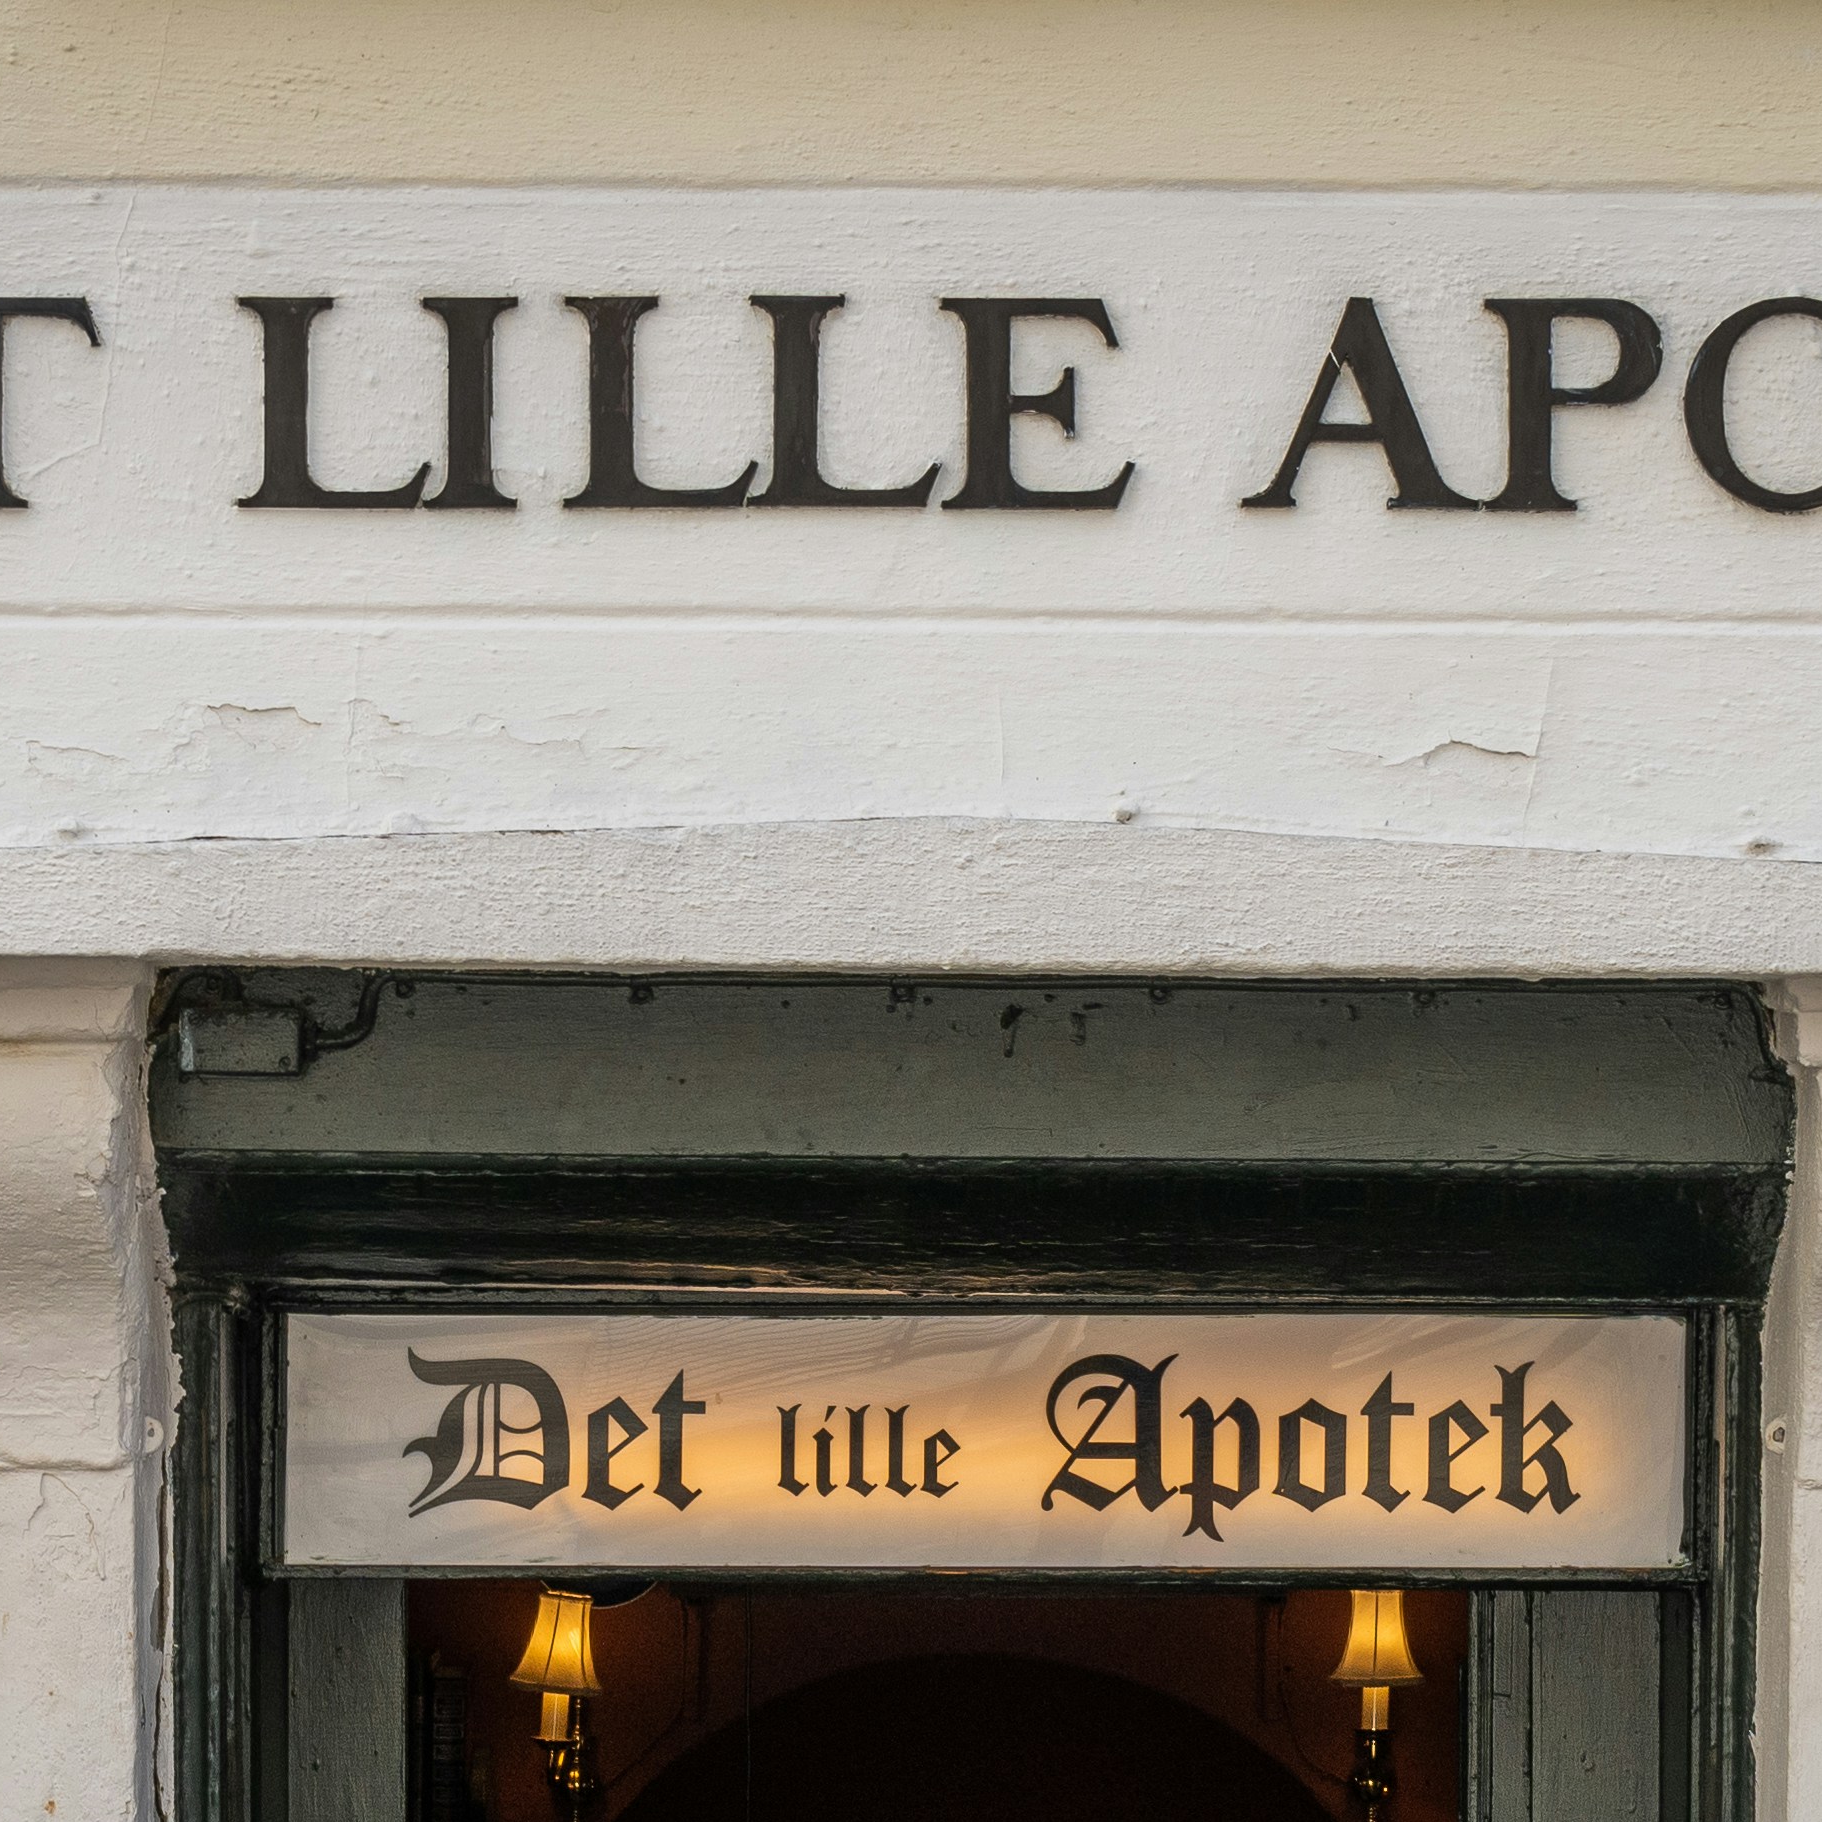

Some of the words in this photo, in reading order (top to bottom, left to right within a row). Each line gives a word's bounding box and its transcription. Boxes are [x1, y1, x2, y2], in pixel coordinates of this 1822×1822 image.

[235, 293, 1136, 512] LILLE
[402, 1347, 706, 1518] Det
[776, 1403, 961, 1498] lille
[1041, 1353, 1581, 1543] Apotek
